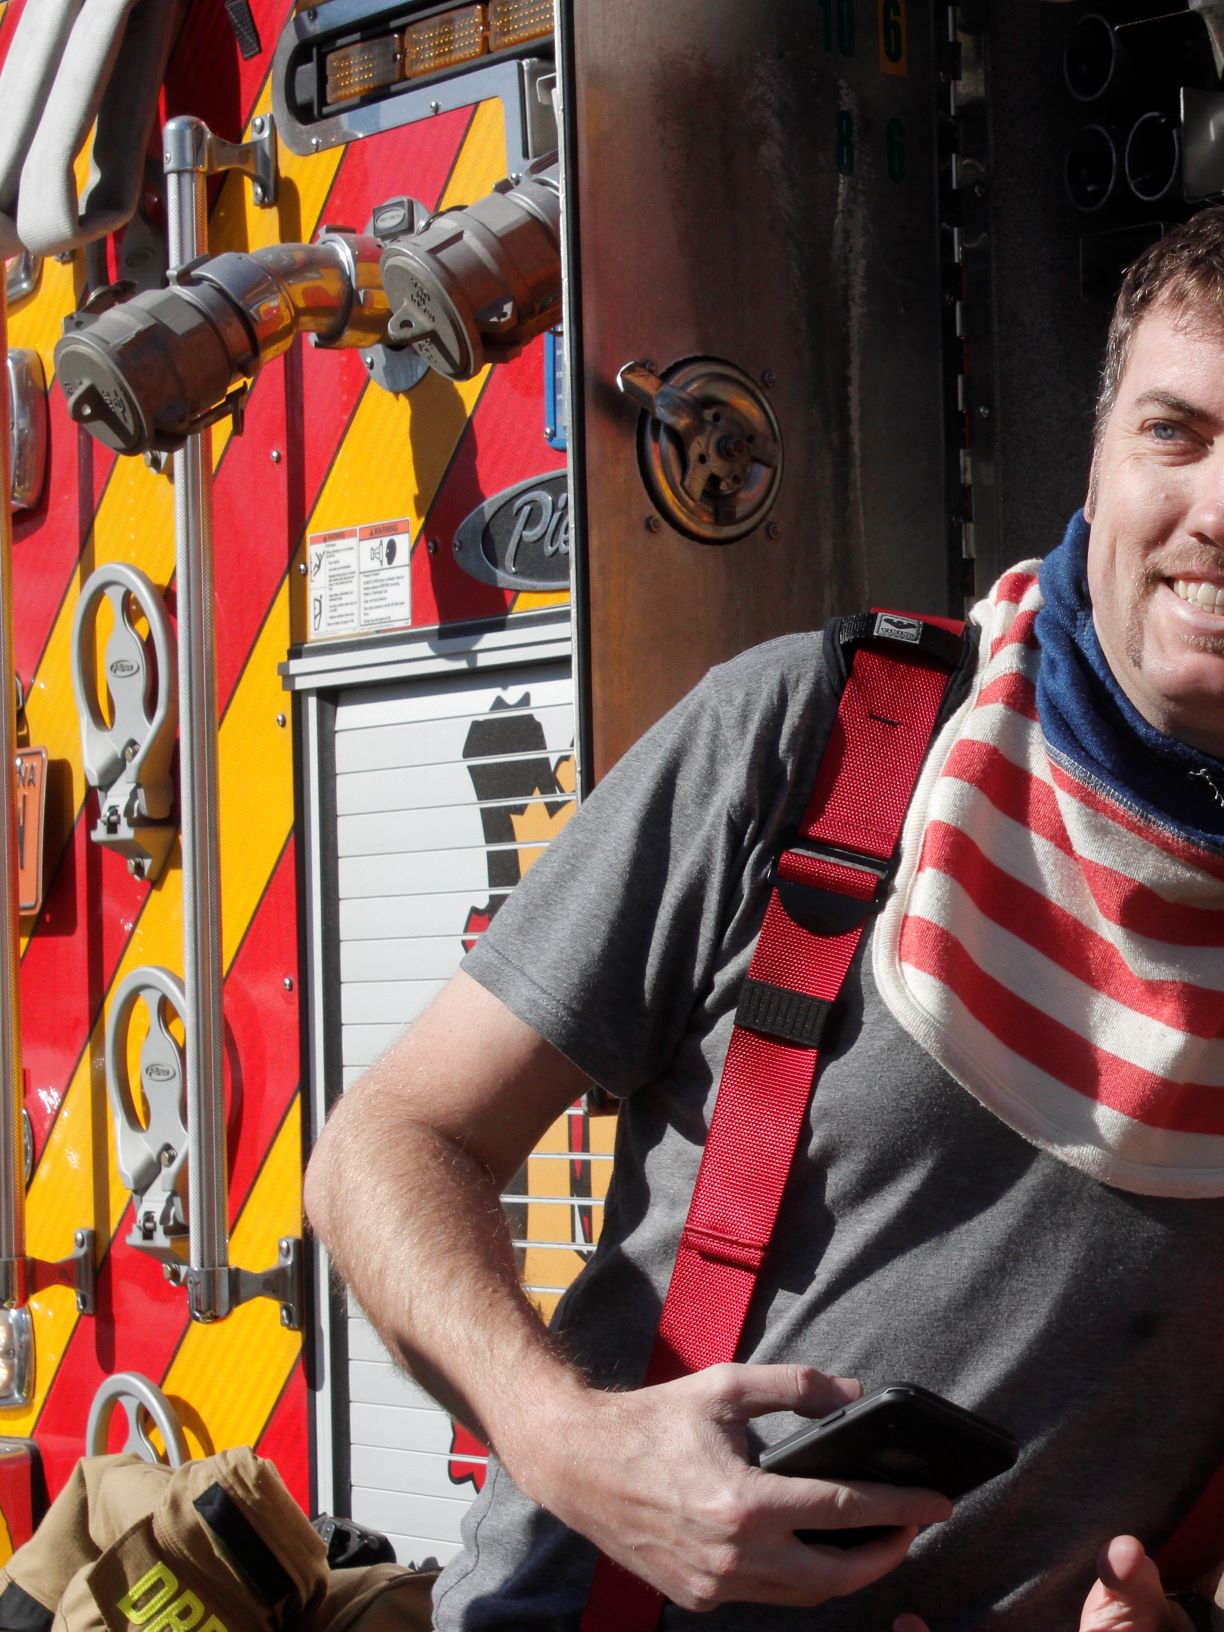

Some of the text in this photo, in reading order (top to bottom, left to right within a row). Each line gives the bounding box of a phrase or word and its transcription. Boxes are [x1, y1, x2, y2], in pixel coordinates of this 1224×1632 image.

[883, 0, 902, 63] 6
[836, 110, 854, 176] 8
[887, 118, 905, 184] 6
